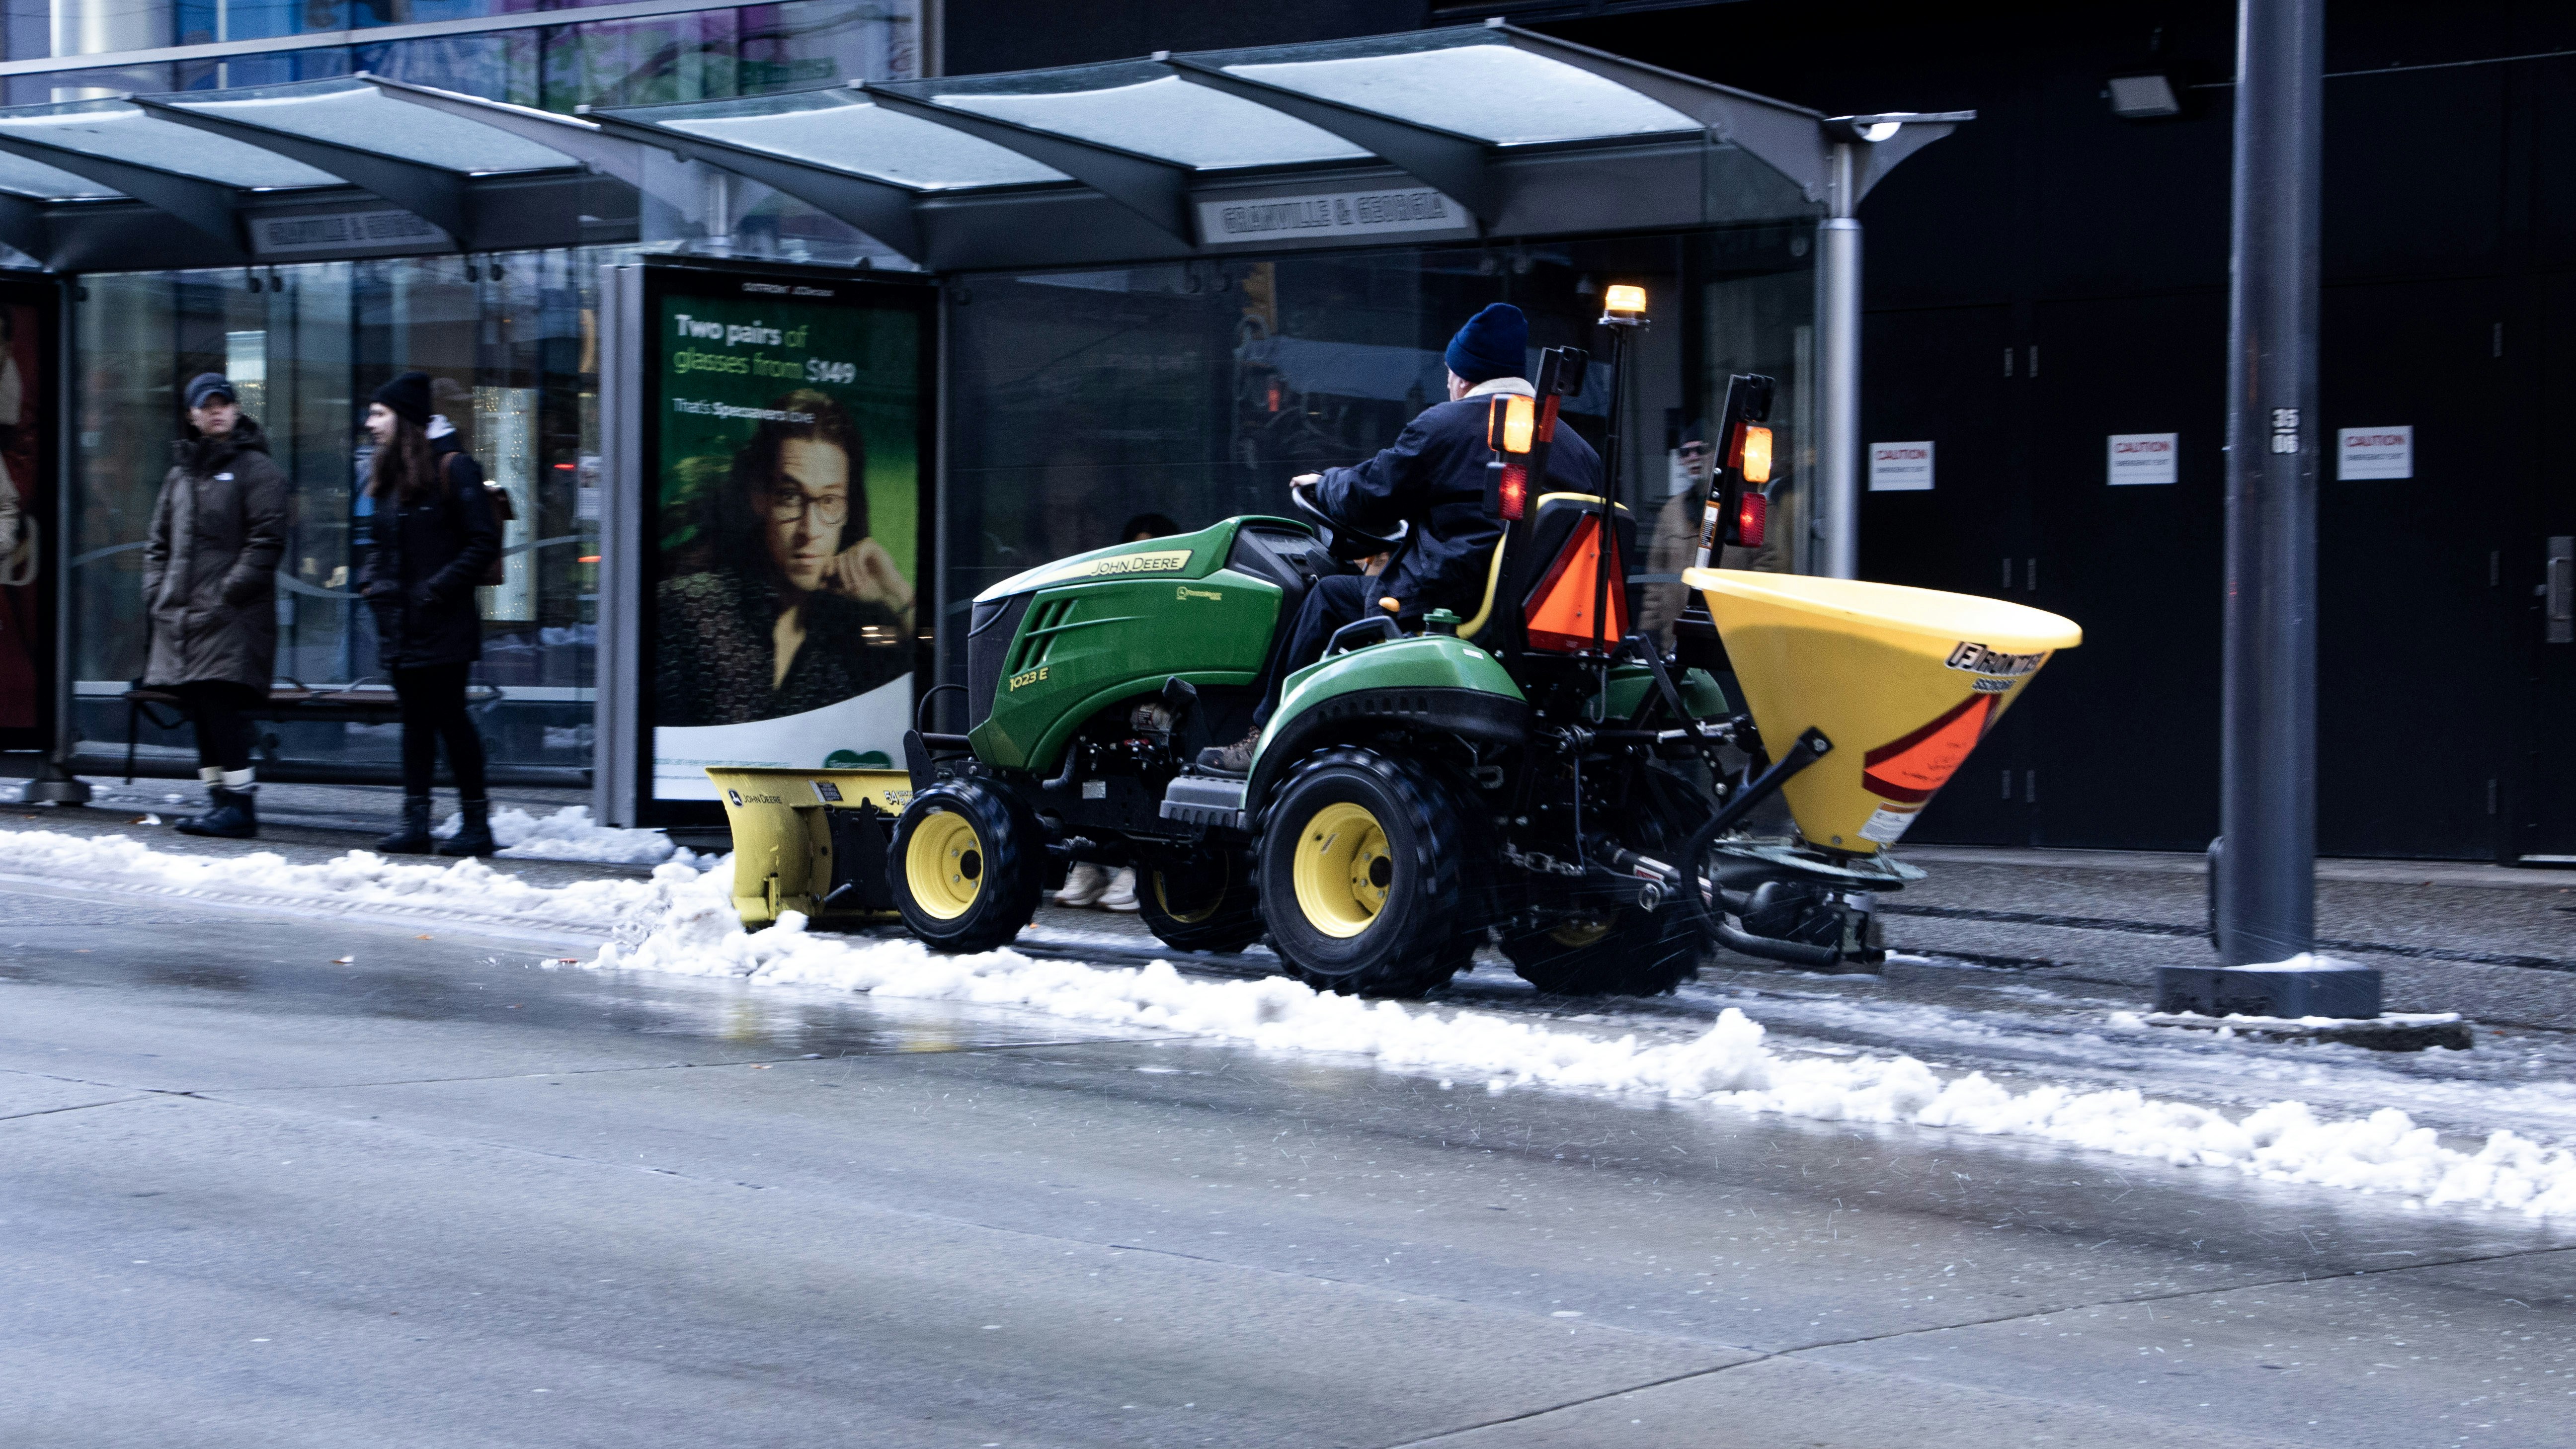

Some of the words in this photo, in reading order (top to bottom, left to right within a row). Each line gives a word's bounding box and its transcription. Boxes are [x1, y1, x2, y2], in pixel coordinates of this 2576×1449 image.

[1335, 198, 1353, 225] &
[674, 314, 724, 339] Two
[725, 320, 782, 346] pairs
[784, 324, 811, 347] of
[673, 347, 749, 374] glasses
[752, 352, 805, 379] from
[2272, 409, 2299, 427] 35
[2116, 441, 2170, 453] CAUTION
[2346, 434, 2405, 447] CAUTION
[1876, 449, 1928, 461] CAUTION
[1091, 560, 1129, 574] JOHN
[1132, 557, 1180, 570] DEERE
[1010, 671, 1037, 692] 1023
[1039, 666, 1049, 681] E
[743, 794, 760, 804] JOHN
[760, 793, 783, 804] DEERE
[884, 790, 899, 805] 54
